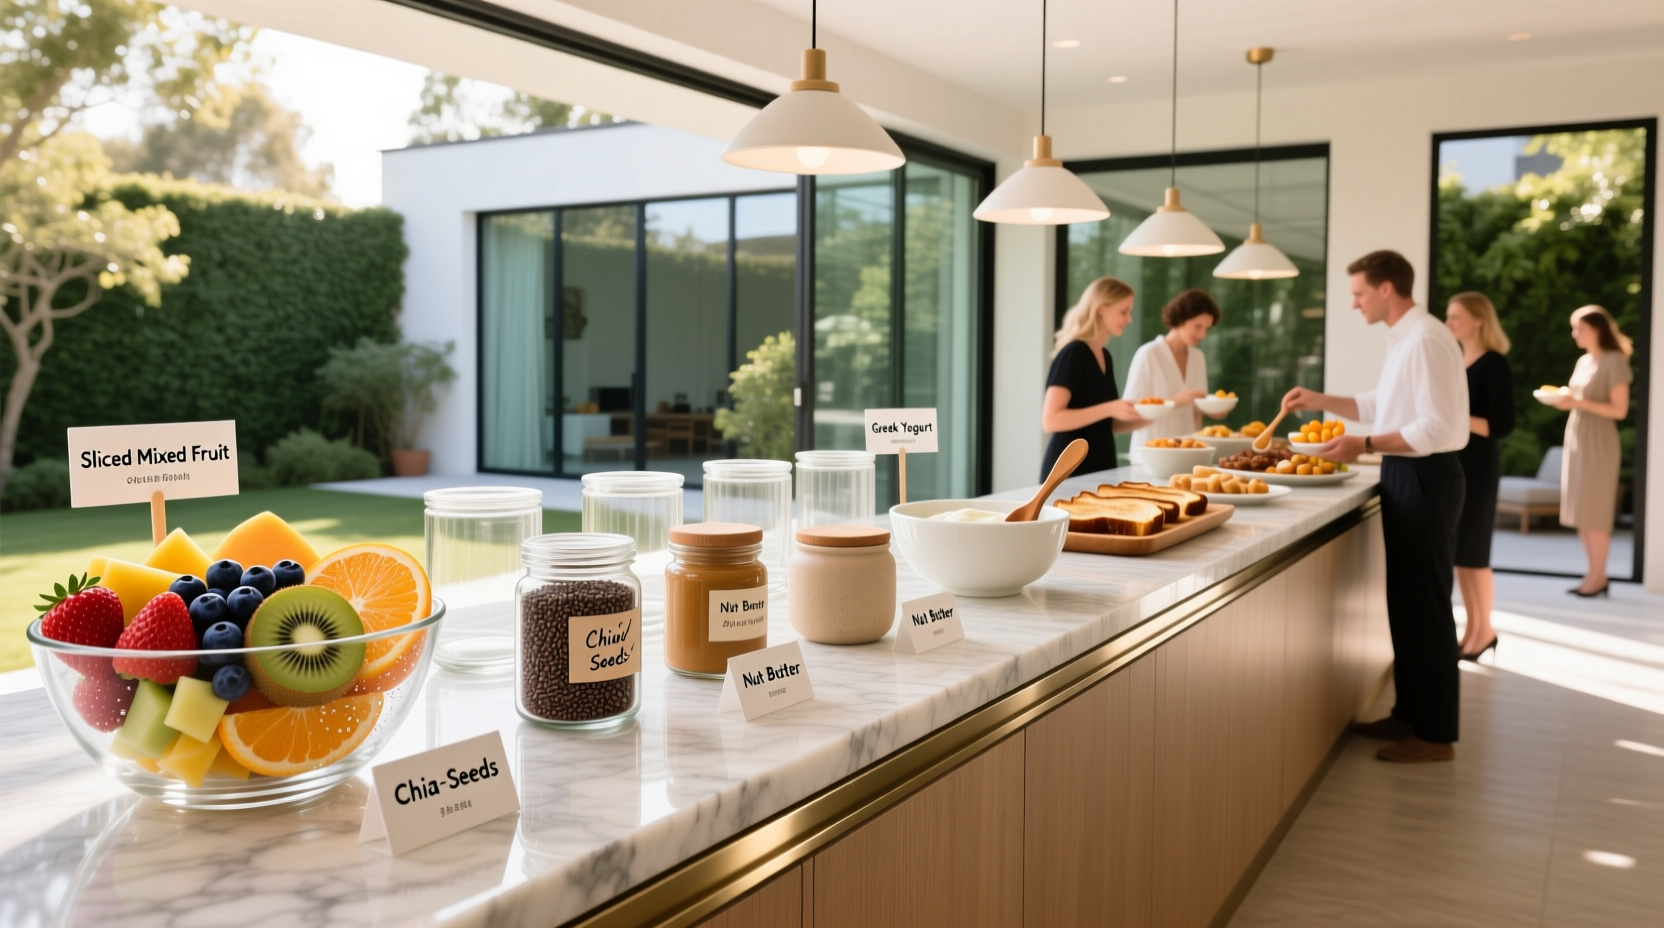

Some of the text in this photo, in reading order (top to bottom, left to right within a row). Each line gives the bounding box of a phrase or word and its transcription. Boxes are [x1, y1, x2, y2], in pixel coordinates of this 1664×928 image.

[872, 421, 933, 436] Greek Yogurt
[80, 444, 230, 469] Sliced Mixed Fruit
[742, 663, 801, 689] Nut Butter
[394, 757, 499, 805] Chia-Seeds
